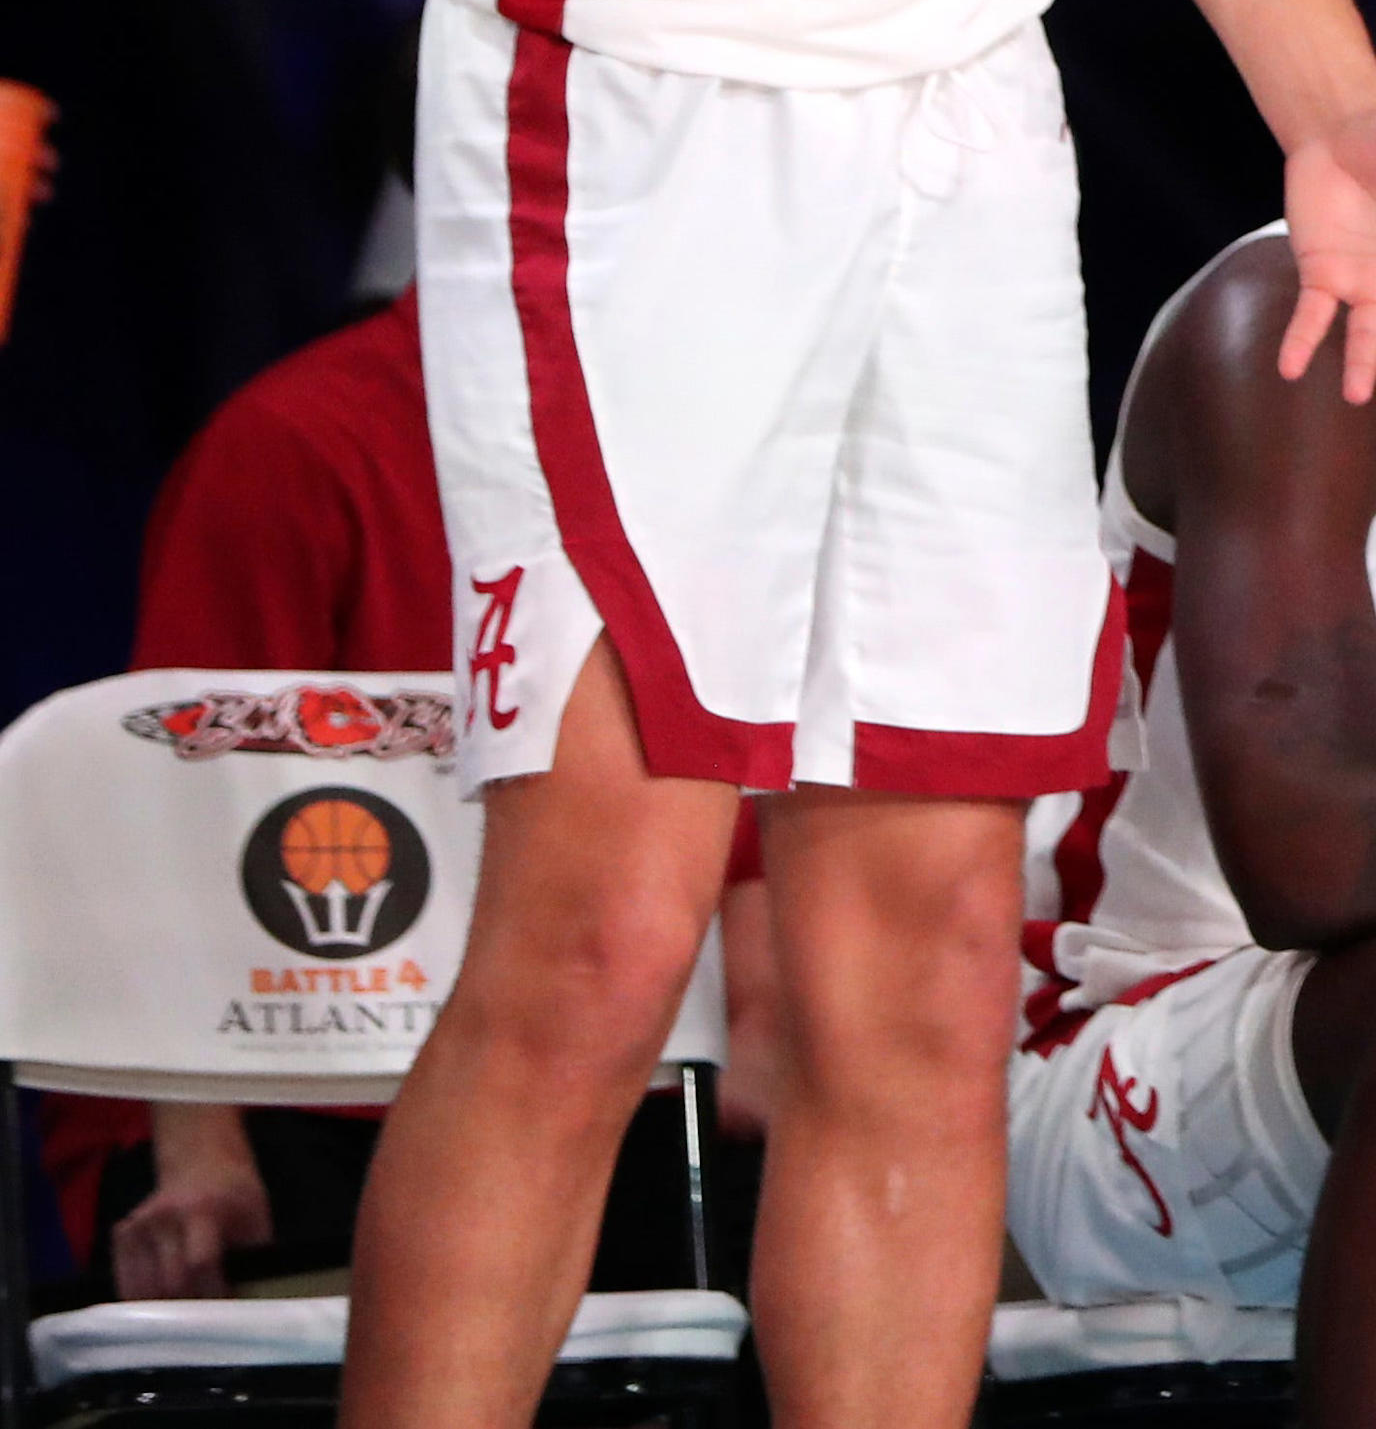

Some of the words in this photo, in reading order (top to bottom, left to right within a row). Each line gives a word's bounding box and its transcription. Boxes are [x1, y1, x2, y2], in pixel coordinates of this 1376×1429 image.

[250, 968, 390, 994] BATTLE
[397, 958, 431, 993] 4
[216, 998, 443, 1035] ATLANT
